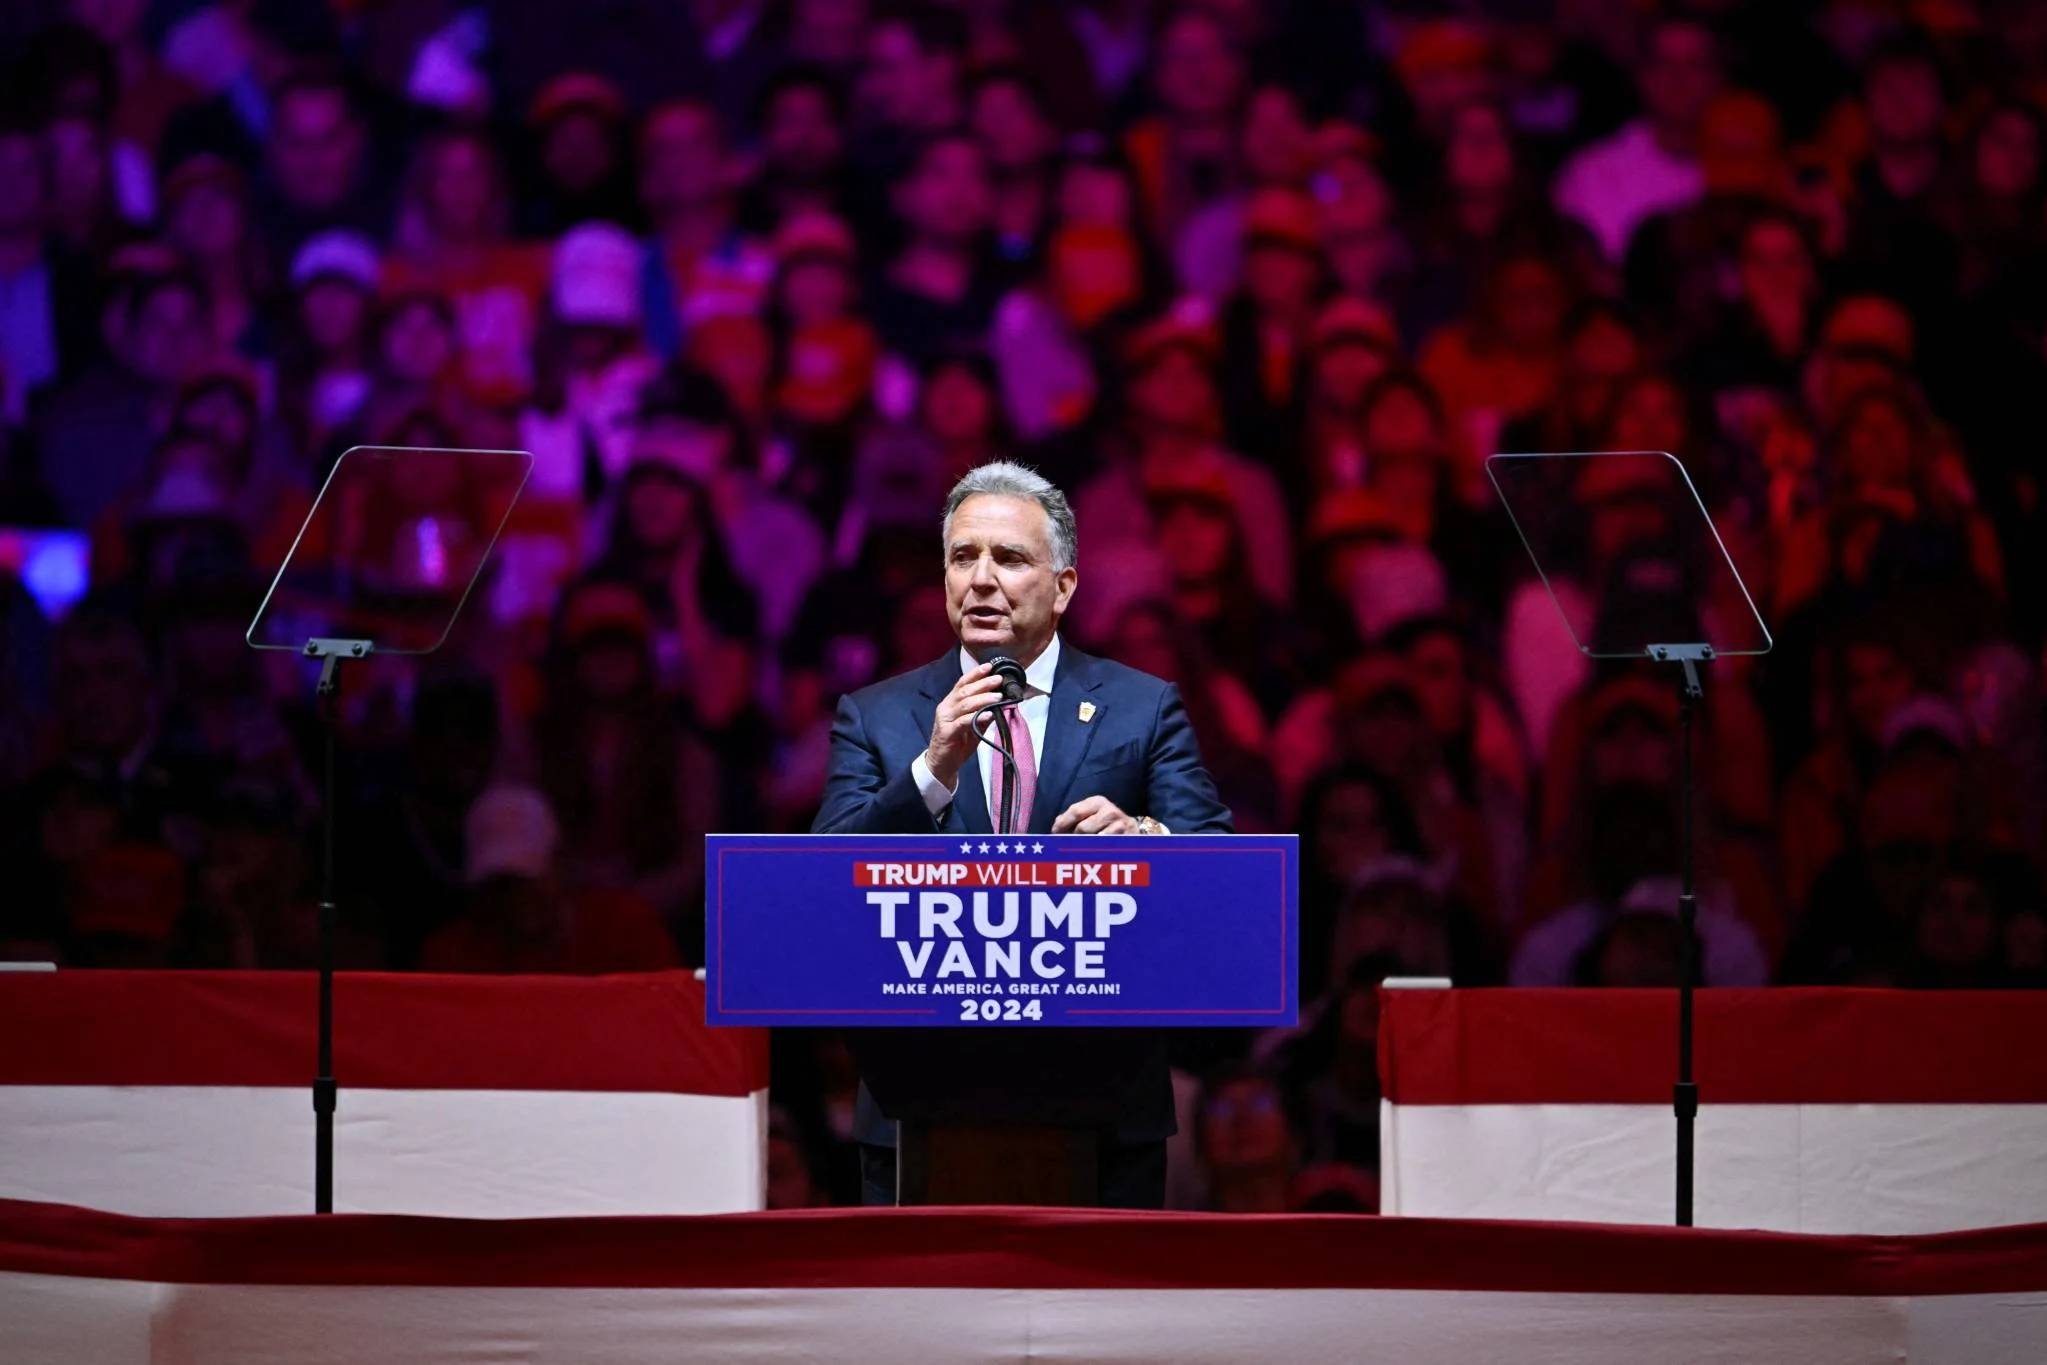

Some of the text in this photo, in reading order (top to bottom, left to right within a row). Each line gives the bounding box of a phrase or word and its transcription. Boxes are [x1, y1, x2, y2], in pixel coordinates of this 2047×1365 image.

[866, 863, 1138, 886] TRUMP WILL FIX IT
[866, 891, 1138, 939] TRUMP
[896, 940, 1106, 979] VANCE
[882, 983, 1121, 995] MAKE AMERICA GREAT AGAIN!
[960, 999, 1043, 1021] 2024
